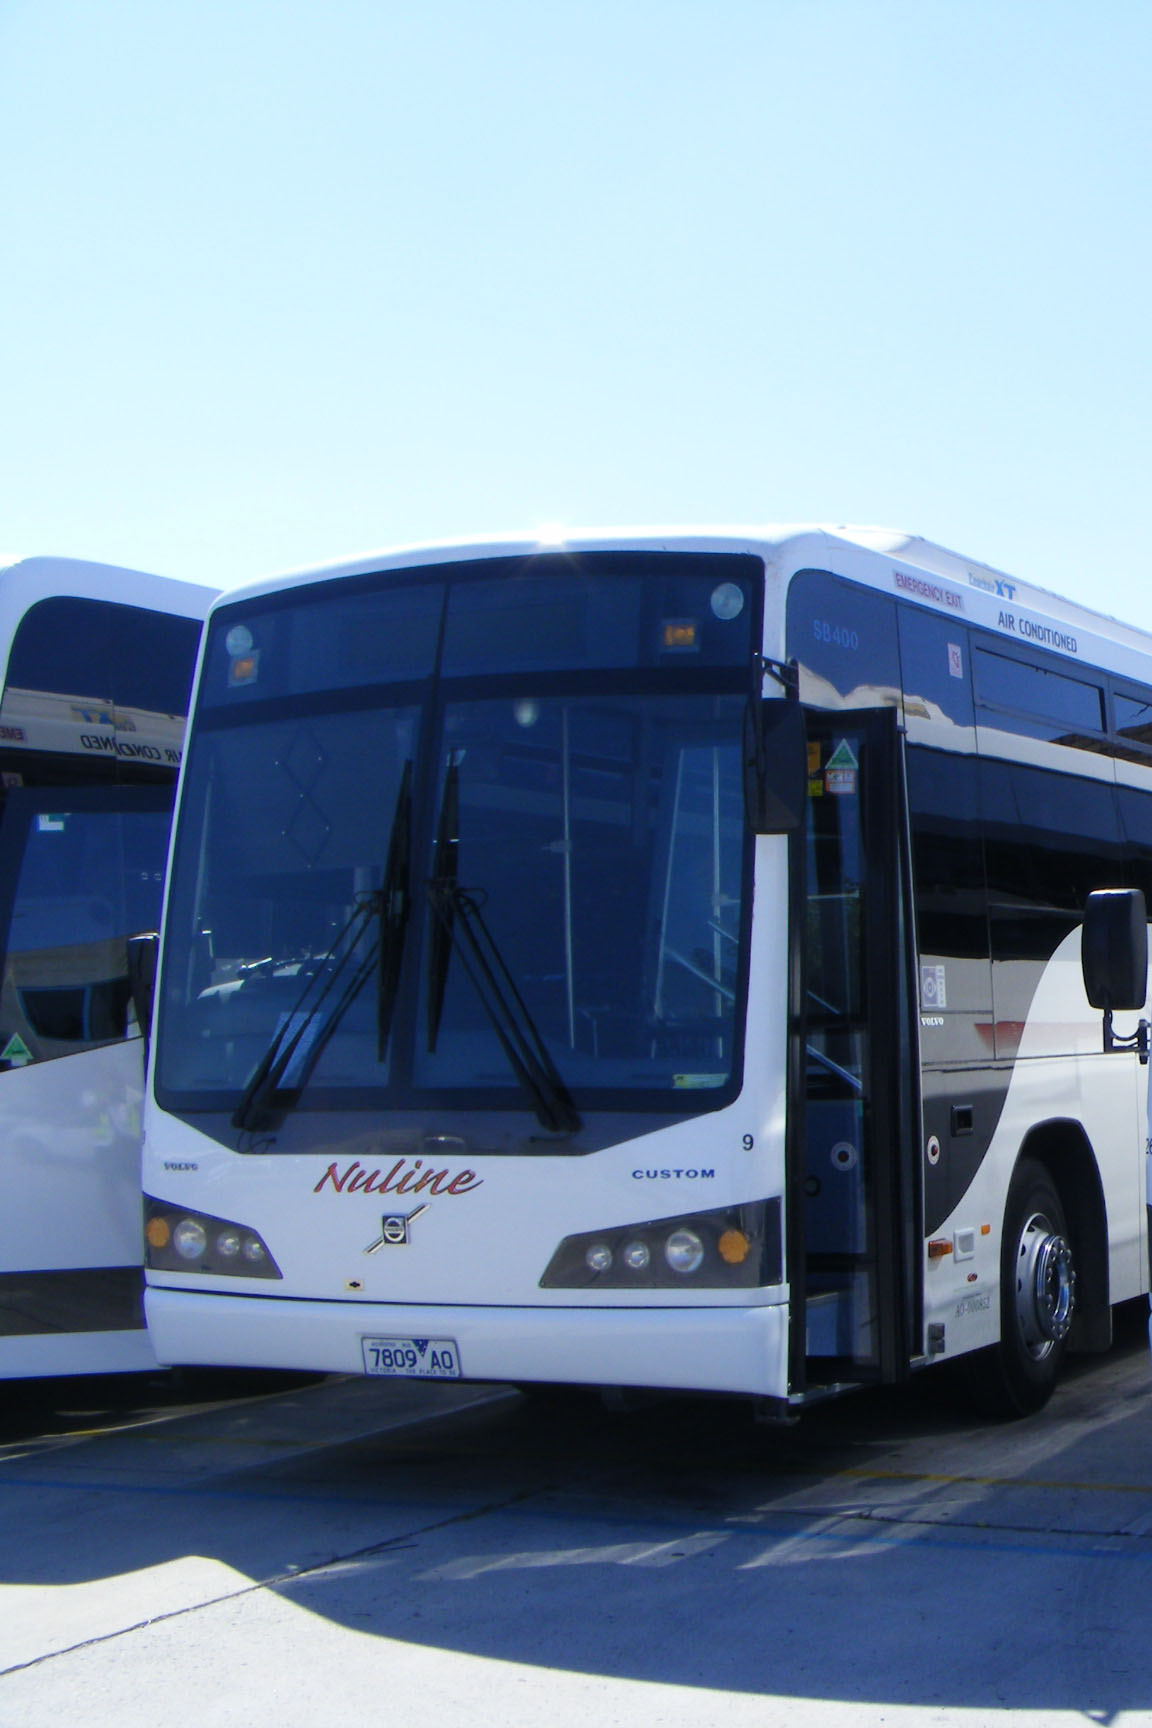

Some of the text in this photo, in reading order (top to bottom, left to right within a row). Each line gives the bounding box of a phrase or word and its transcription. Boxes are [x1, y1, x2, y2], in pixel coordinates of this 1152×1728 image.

[895, 573, 943, 601] EMERGENCY
[946, 589, 963, 609] EXIT
[813, 619, 859, 650] SB400
[998, 610, 1078, 652] AIR CONDITIONED
[920, 1016, 945, 1027] VOLVO
[742, 1133, 754, 1151] 9
[313, 1158, 484, 1196] Nuline
[631, 1168, 716, 1180] CUSTOM
[368, 1348, 454, 1370] 7809 AO
